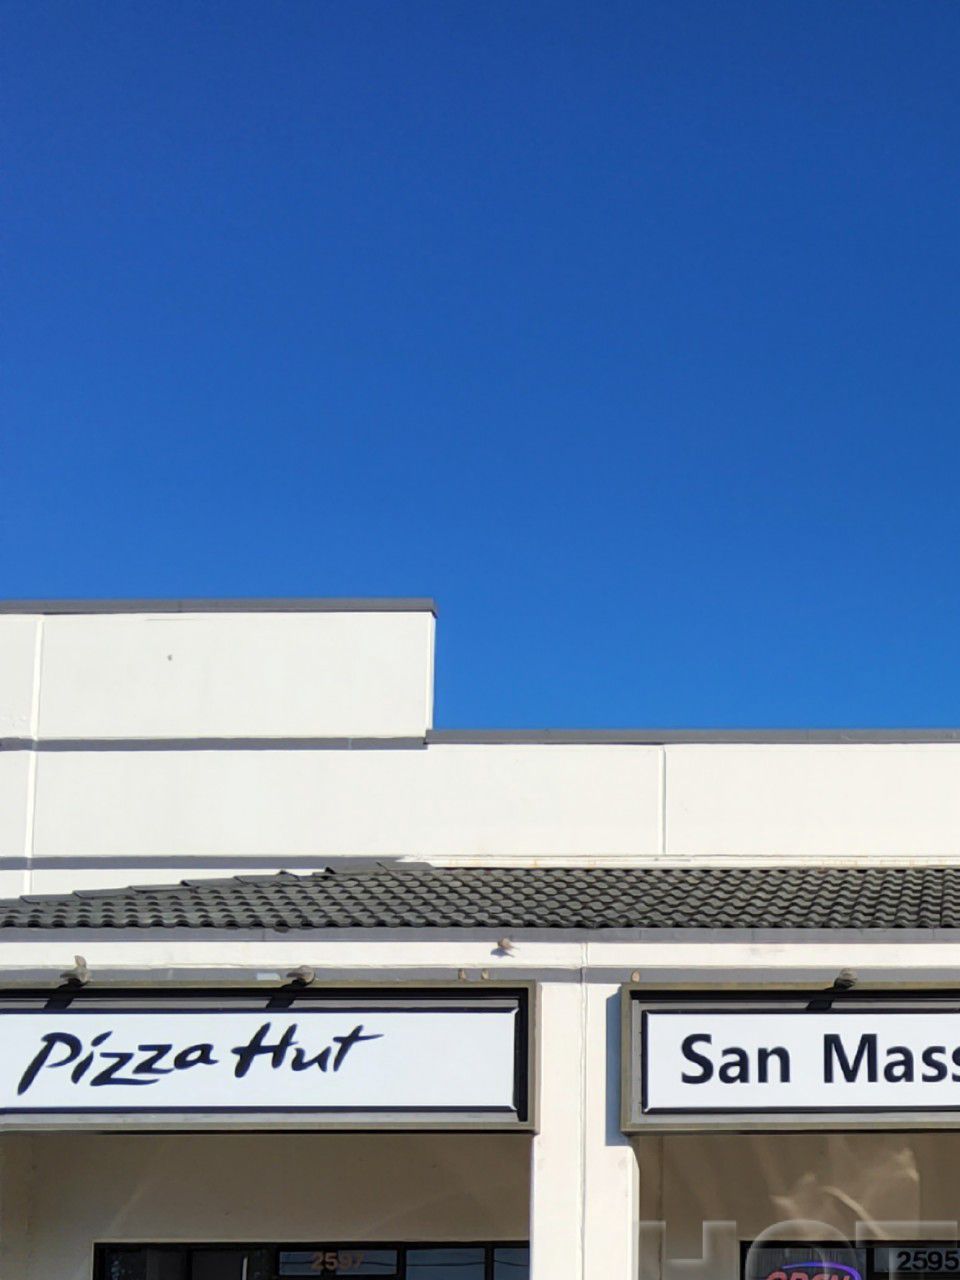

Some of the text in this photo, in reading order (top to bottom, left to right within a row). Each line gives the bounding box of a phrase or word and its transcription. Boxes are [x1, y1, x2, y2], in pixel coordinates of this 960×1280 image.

[17, 1021, 384, 1096] Pizza Hut
[680, 1033, 791, 1084] San
[310, 1251, 367, 1271] 2597
[896, 1250, 960, 1271] 2595
